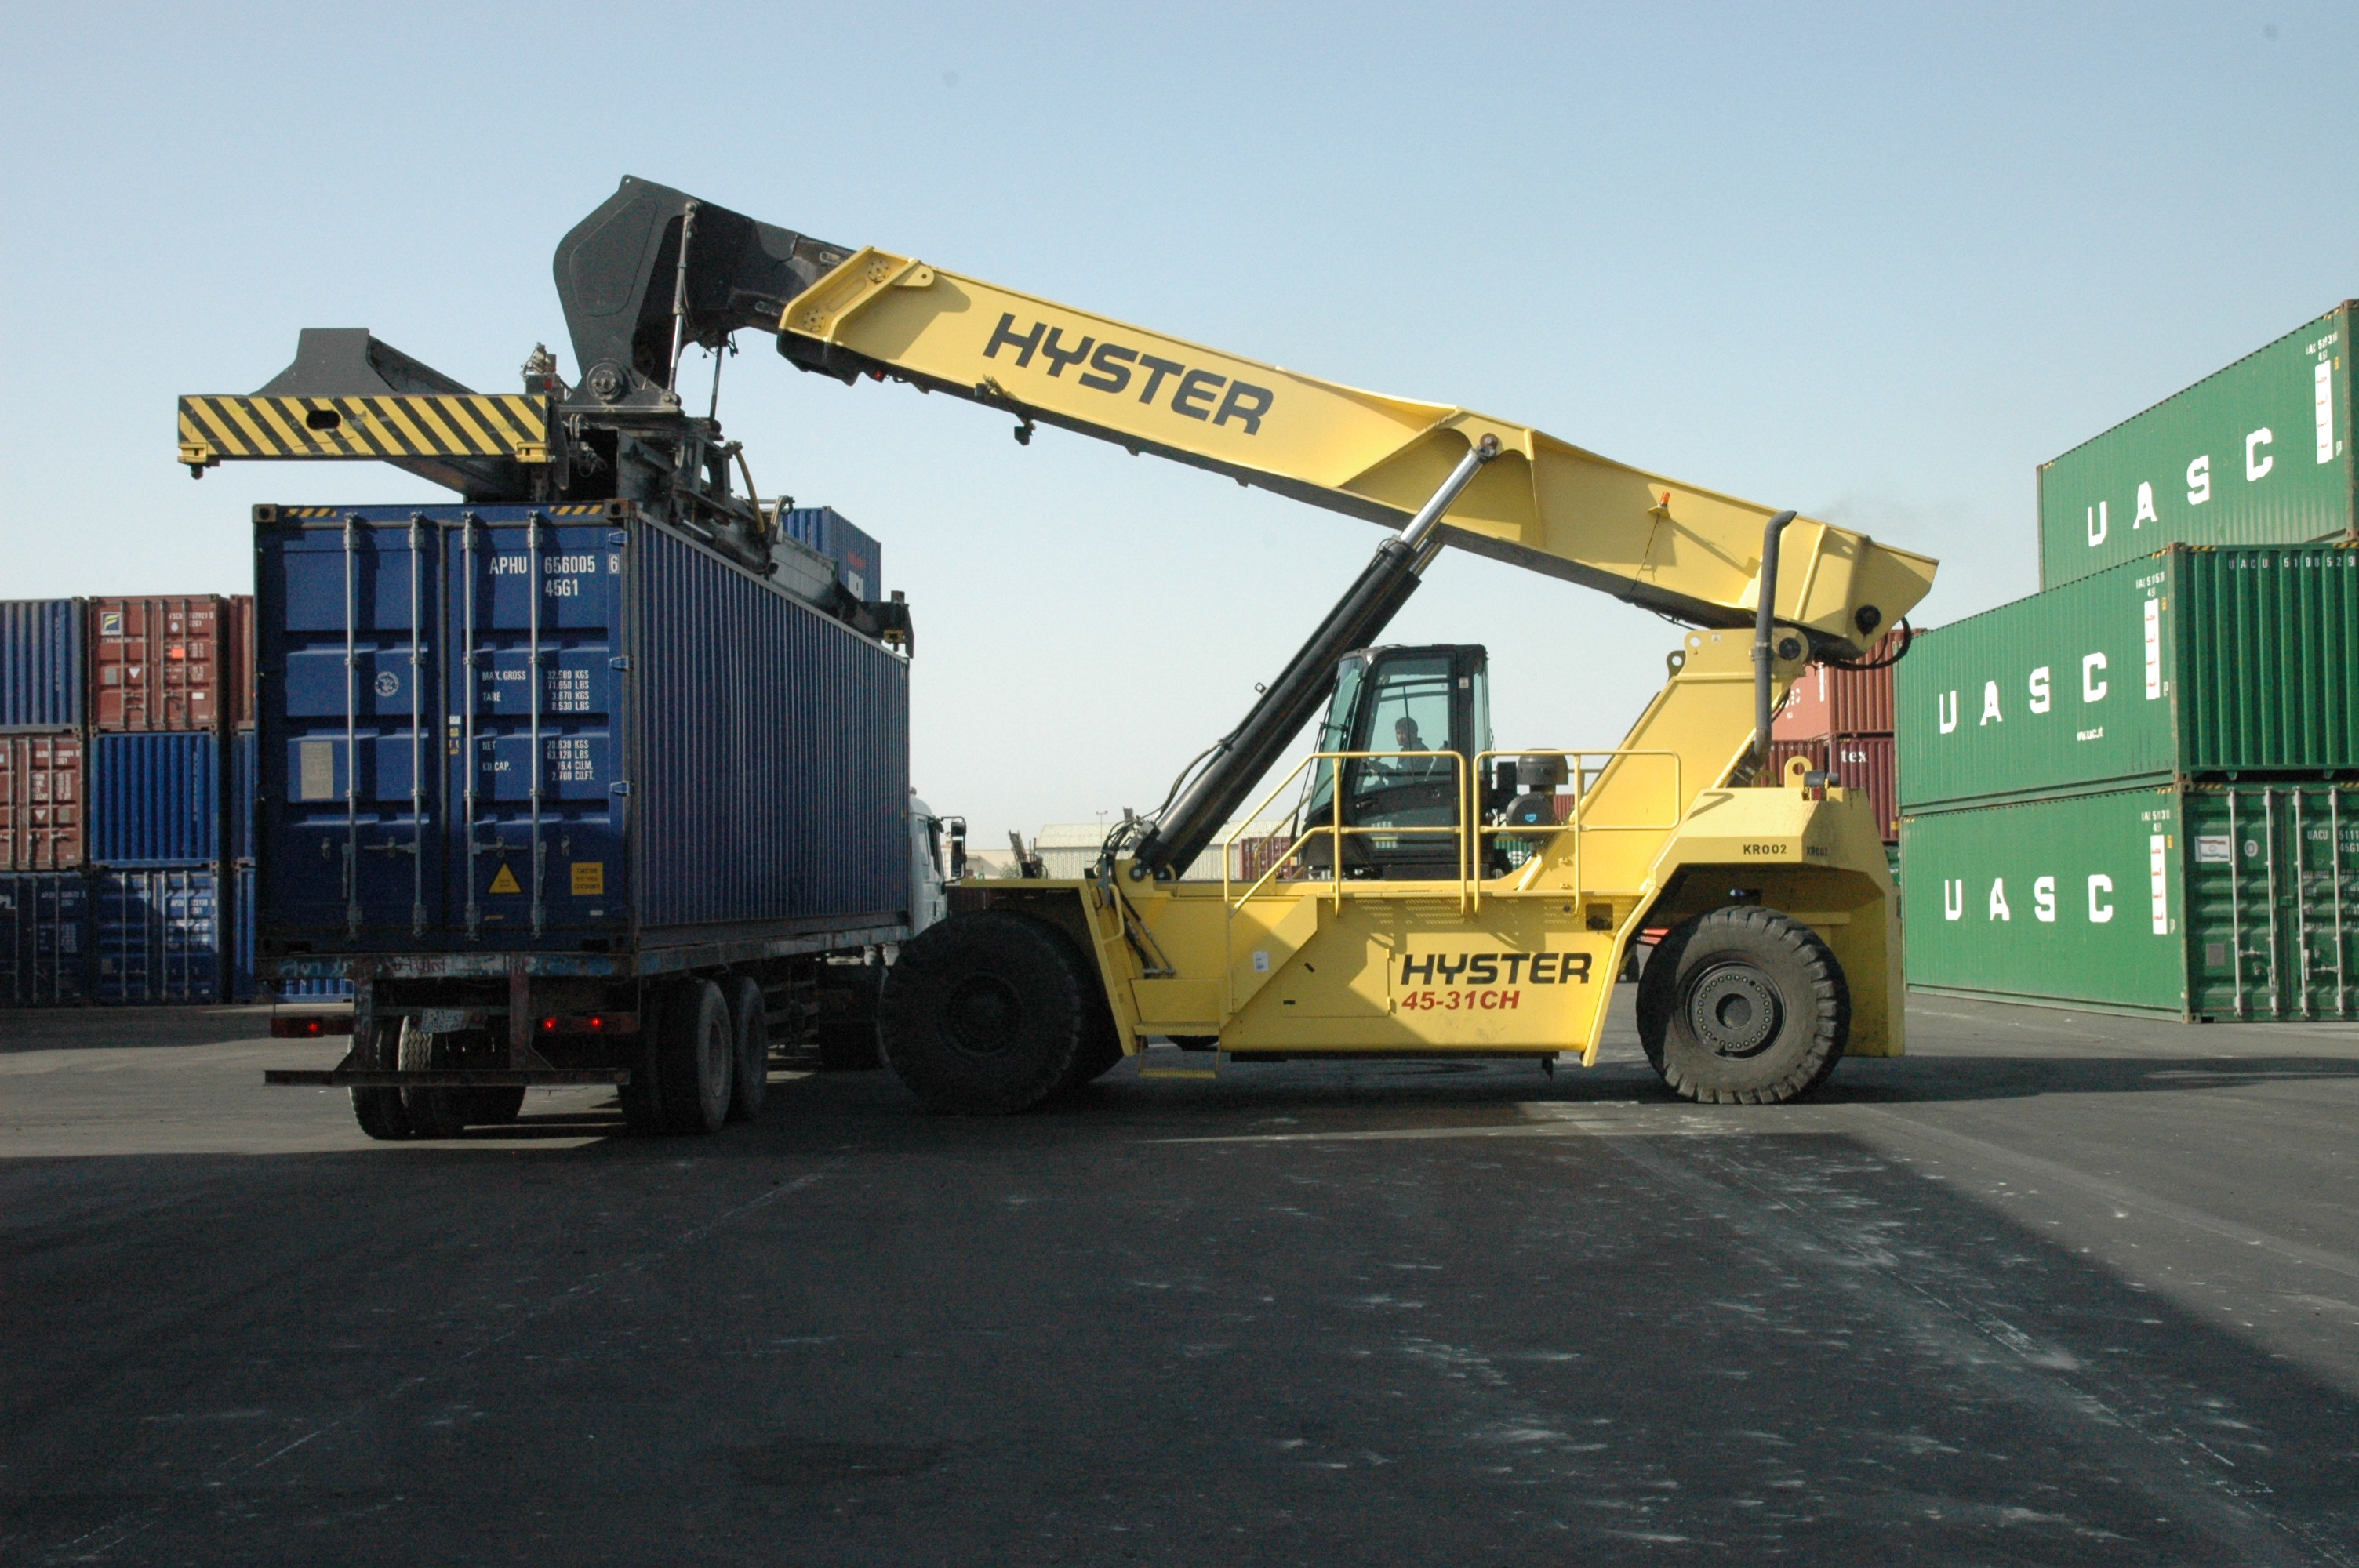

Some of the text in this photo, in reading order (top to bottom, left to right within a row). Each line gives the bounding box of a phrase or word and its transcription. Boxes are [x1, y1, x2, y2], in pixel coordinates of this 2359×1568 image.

[983, 312, 1274, 436] HYSTER
[2088, 427, 2273, 546] UASC
[489, 554, 620, 574] APHU 656005 6
[545, 579, 578, 597] 45G1
[547, 670, 572, 680] 32.500
[575, 670, 589, 679] KGS
[575, 681, 589, 689] LBS
[482, 691, 589, 702] TARE 3.870 KGS
[1939, 652, 2107, 734] UASC
[552, 702, 589, 710] 8.530 LBS
[482, 740, 496, 750] NET
[574, 739, 589, 750] KGS
[547, 750, 589, 760] 63.120 LBS
[1840, 748, 1868, 764] tex
[552, 771, 572, 781] 2.700
[2307, 830, 2328, 840] UACU
[1743, 844, 1787, 855] KR002
[2339, 842, 2359, 852] 45G1
[1945, 874, 2113, 923] UASC
[1401, 953, 1593, 985] HYSTER
[1401, 990, 1521, 1010] 45-31CH
